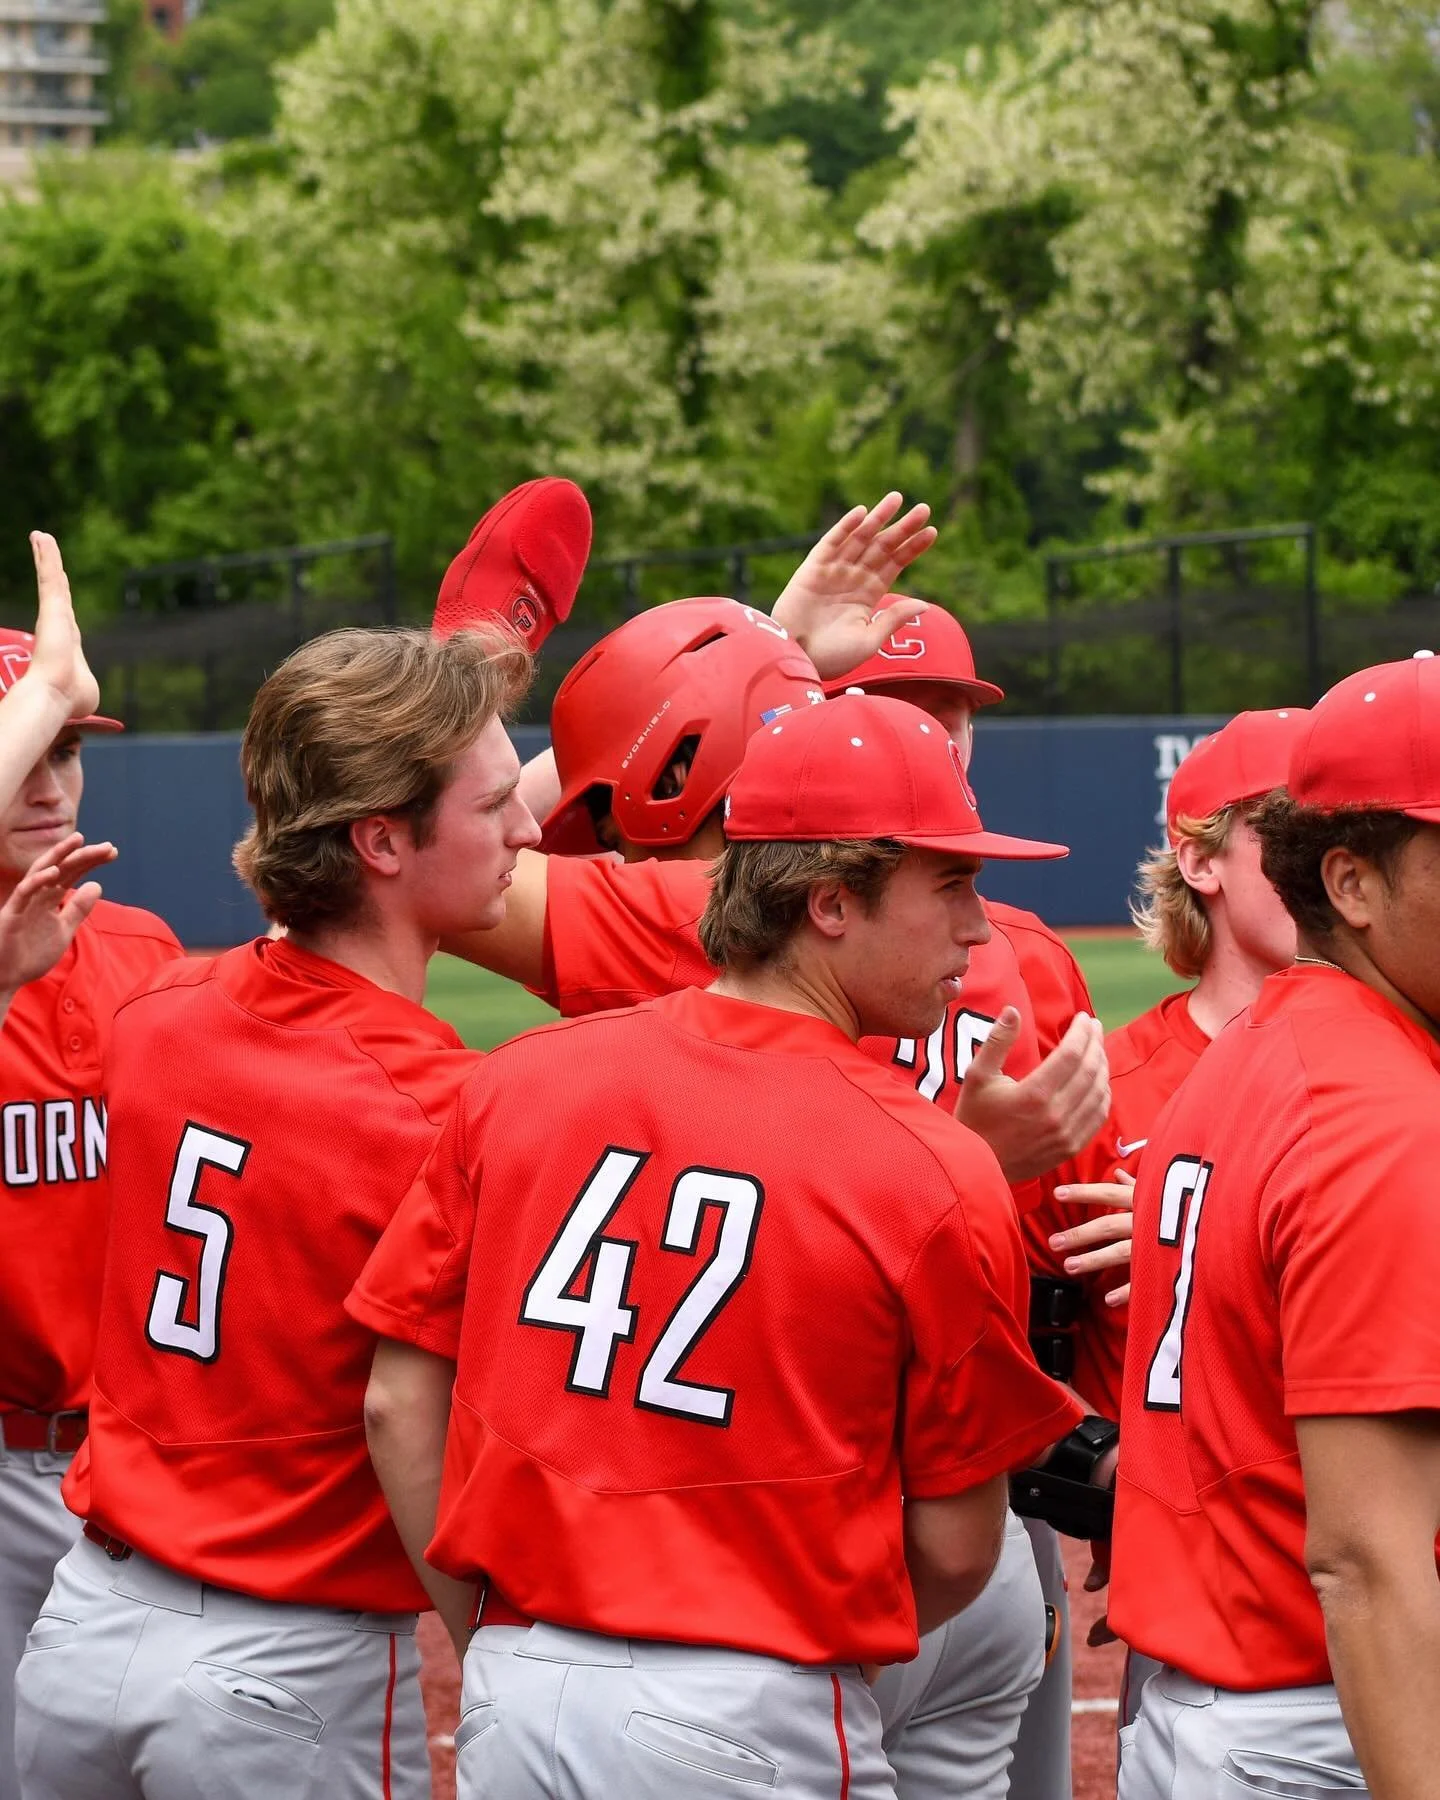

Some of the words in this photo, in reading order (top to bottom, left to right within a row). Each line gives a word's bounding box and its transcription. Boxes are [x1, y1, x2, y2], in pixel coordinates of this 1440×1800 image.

[621, 700, 671, 769] EVOSHIELD
[144, 1119, 252, 1365] 5
[517, 1143, 766, 1428] 42
